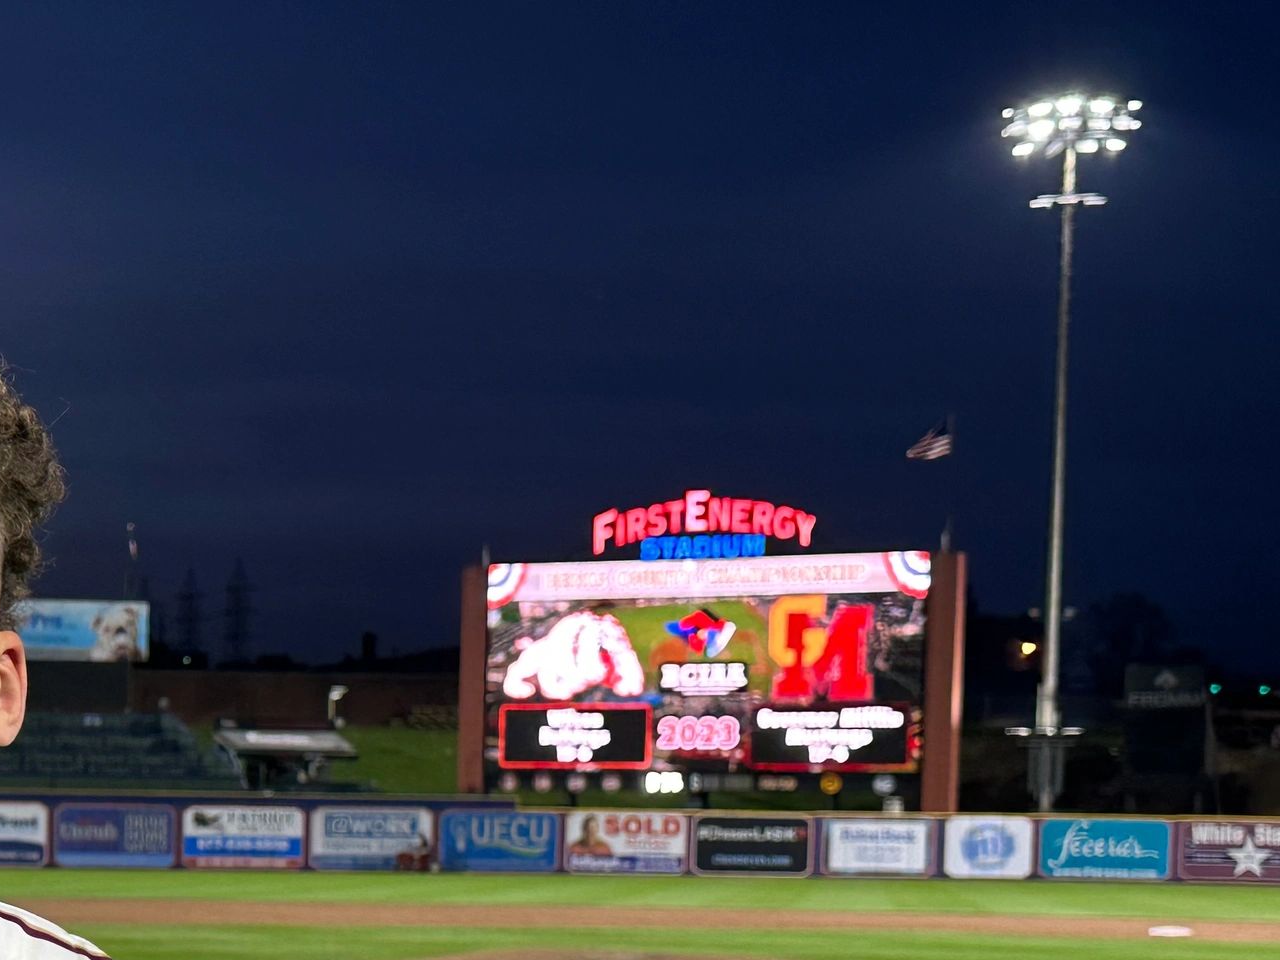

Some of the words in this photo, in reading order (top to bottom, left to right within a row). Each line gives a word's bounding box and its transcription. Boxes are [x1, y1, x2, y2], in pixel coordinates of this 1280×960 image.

[640, 534, 766, 560] STADIUM
[656, 715, 741, 751] 2023
[471, 815, 552, 846] UECU
[605, 814, 681, 837] SOLD
[1191, 822, 1244, 845] White
